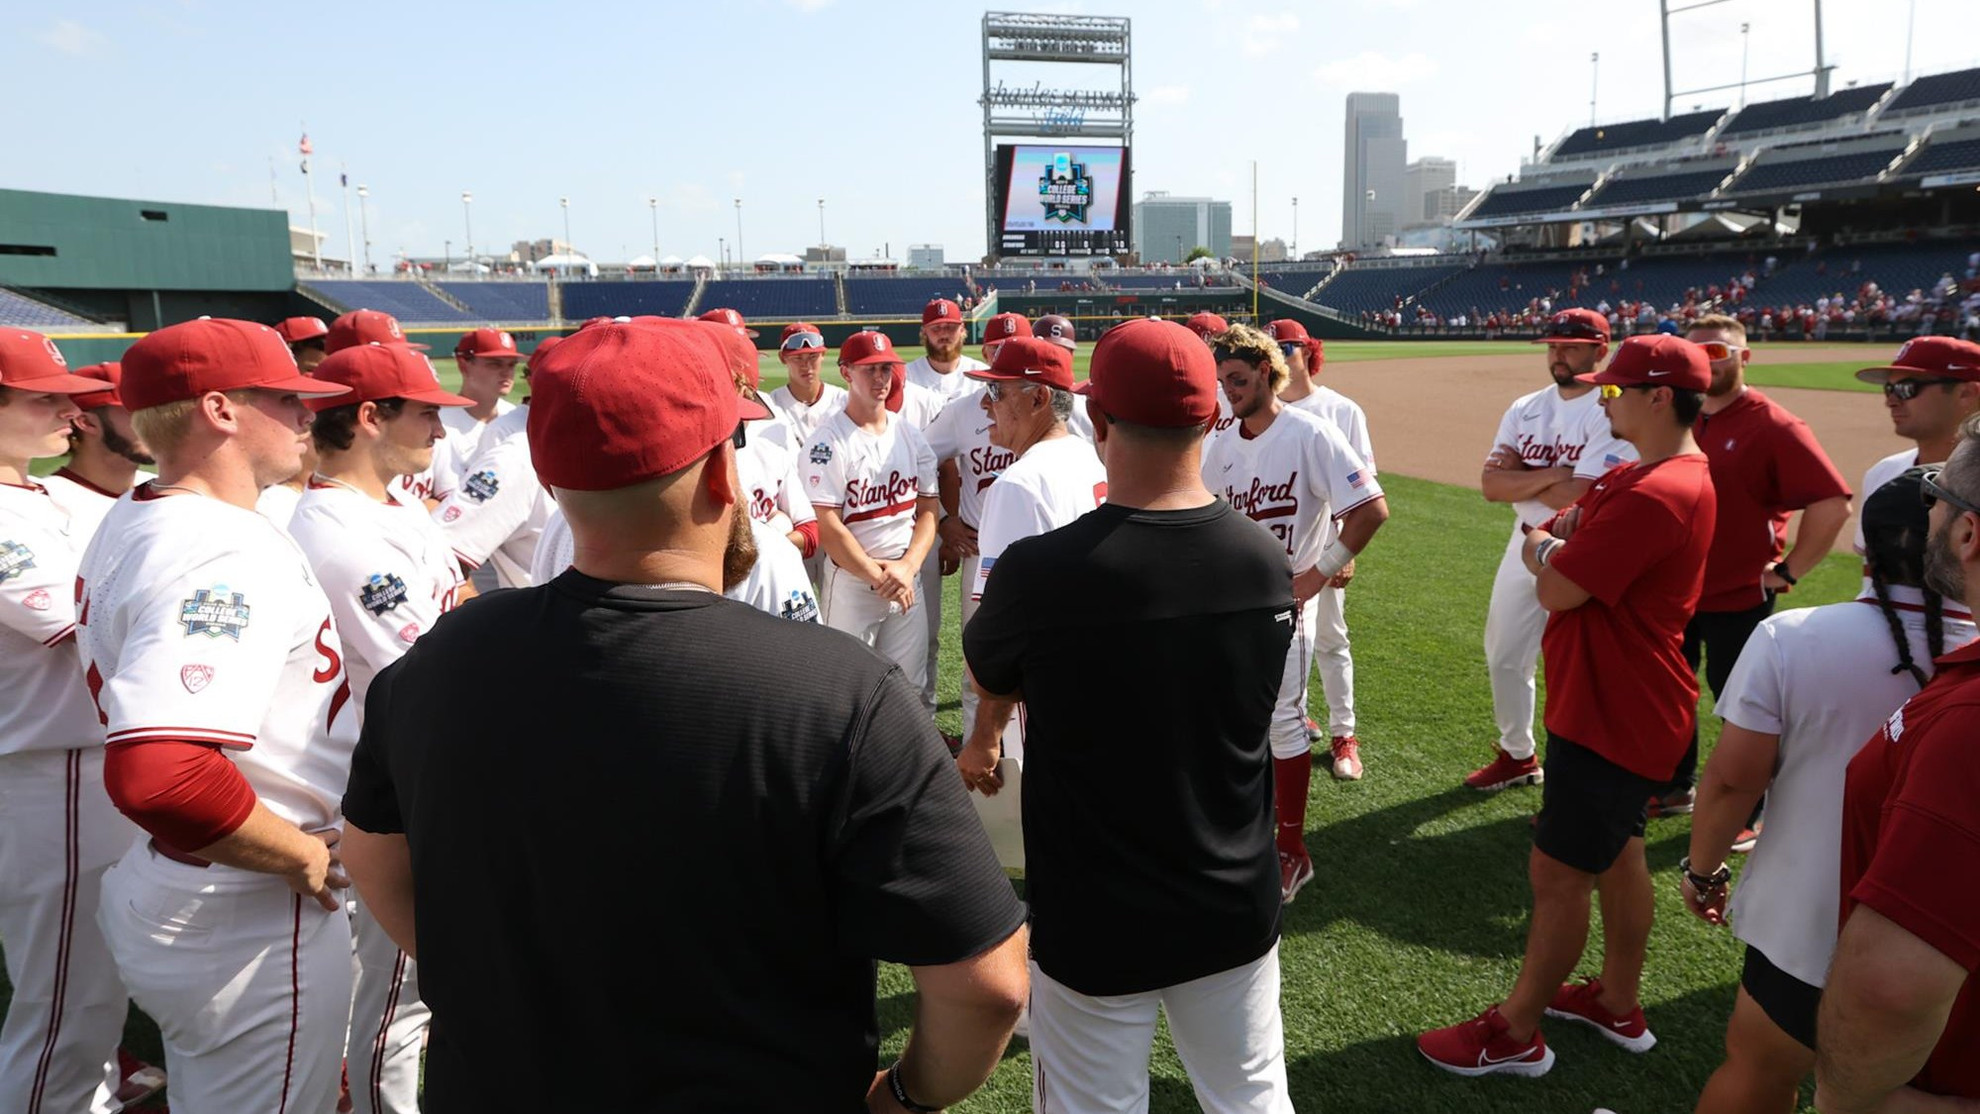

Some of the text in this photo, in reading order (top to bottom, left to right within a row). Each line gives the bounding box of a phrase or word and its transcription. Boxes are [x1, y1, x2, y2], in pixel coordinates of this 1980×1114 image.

[1047, 184, 1077, 195] COLLEGE
[1039, 194, 1087, 205] WORLD SERIES
[1052, 325, 1062, 339] S
[1225, 470, 1298, 517] tanford
[197, 605, 238, 617] COLLEGE
[182, 613, 217, 622] WORLD
